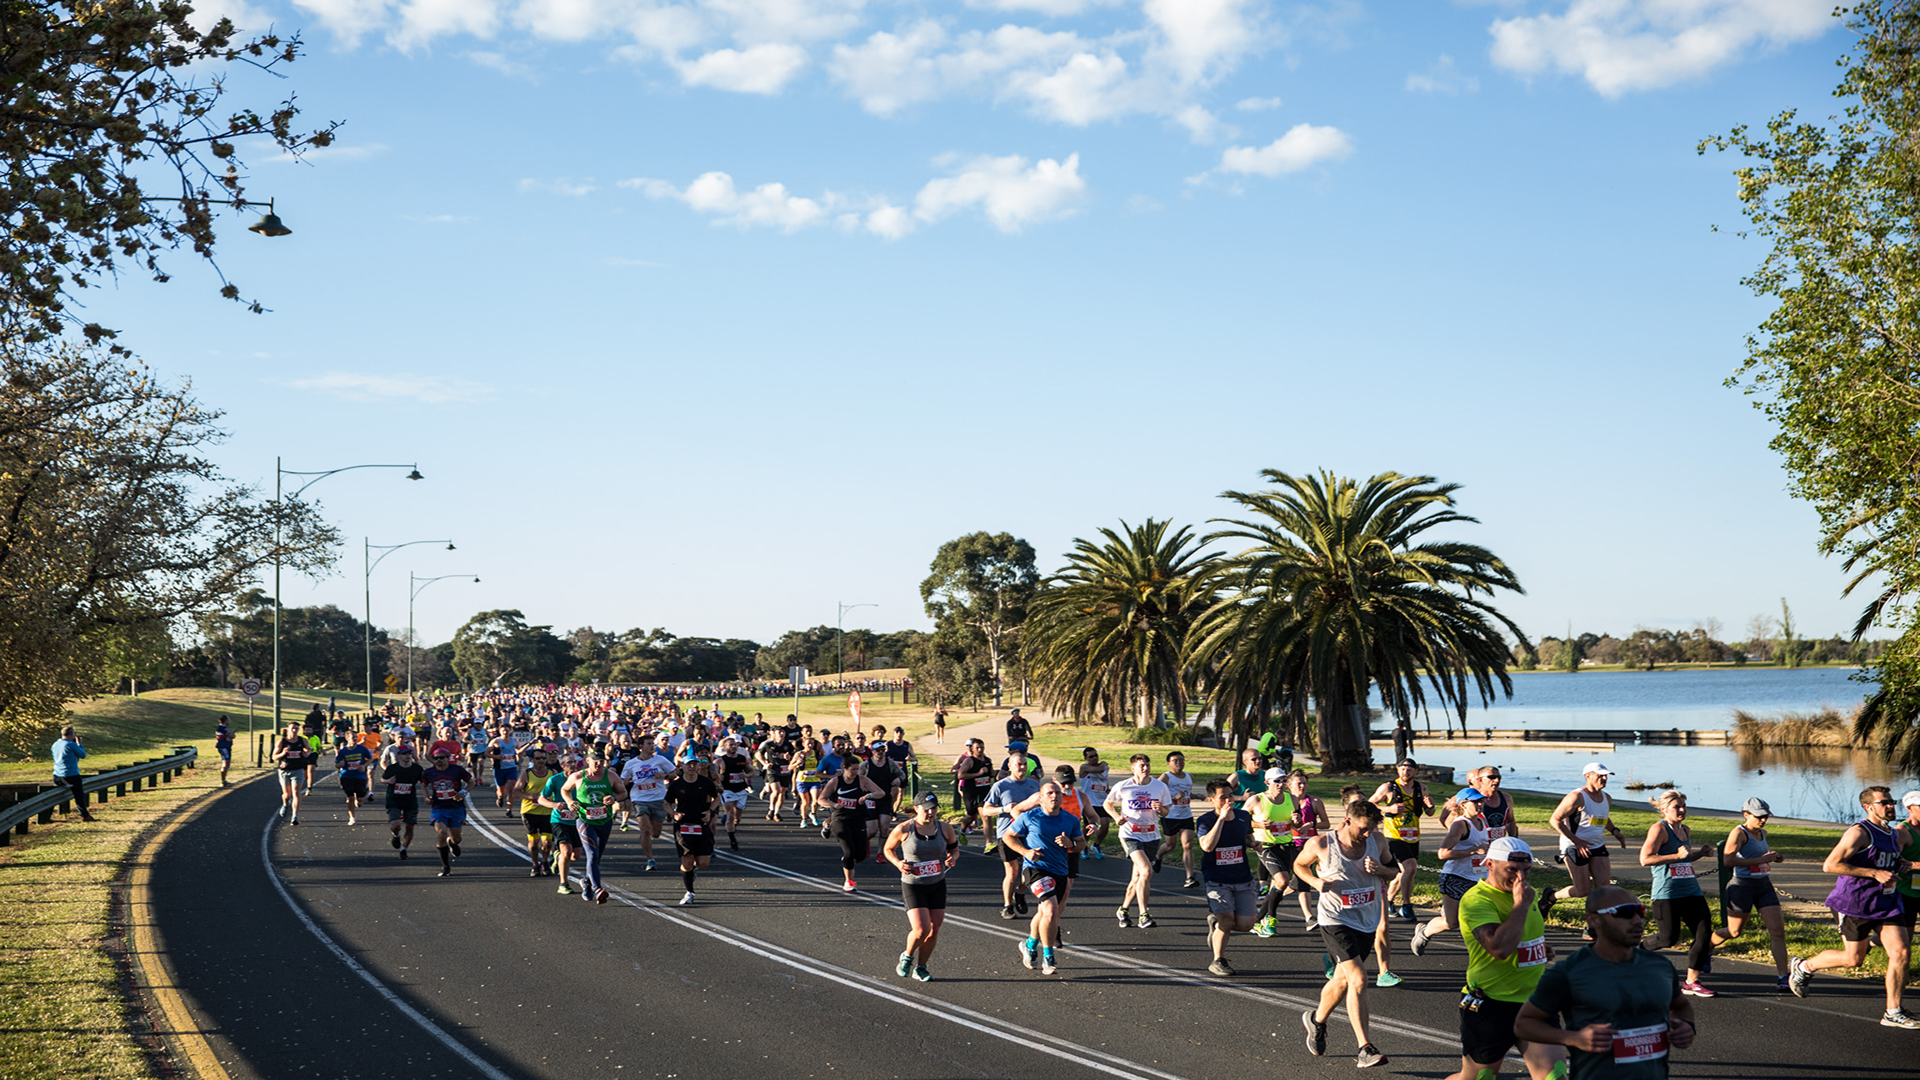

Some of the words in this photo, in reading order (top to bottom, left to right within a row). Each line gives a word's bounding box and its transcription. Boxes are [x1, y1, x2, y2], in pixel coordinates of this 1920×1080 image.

[246, 684, 257, 692] 50
[1221, 850, 1239, 859] 6557
[919, 864, 938, 875] 5420
[1348, 892, 1371, 905] 5357
[1525, 943, 1547, 962] 7137
[1624, 1034, 1662, 1048] RODRIGUES
[1635, 1044, 1654, 1055] 3741
